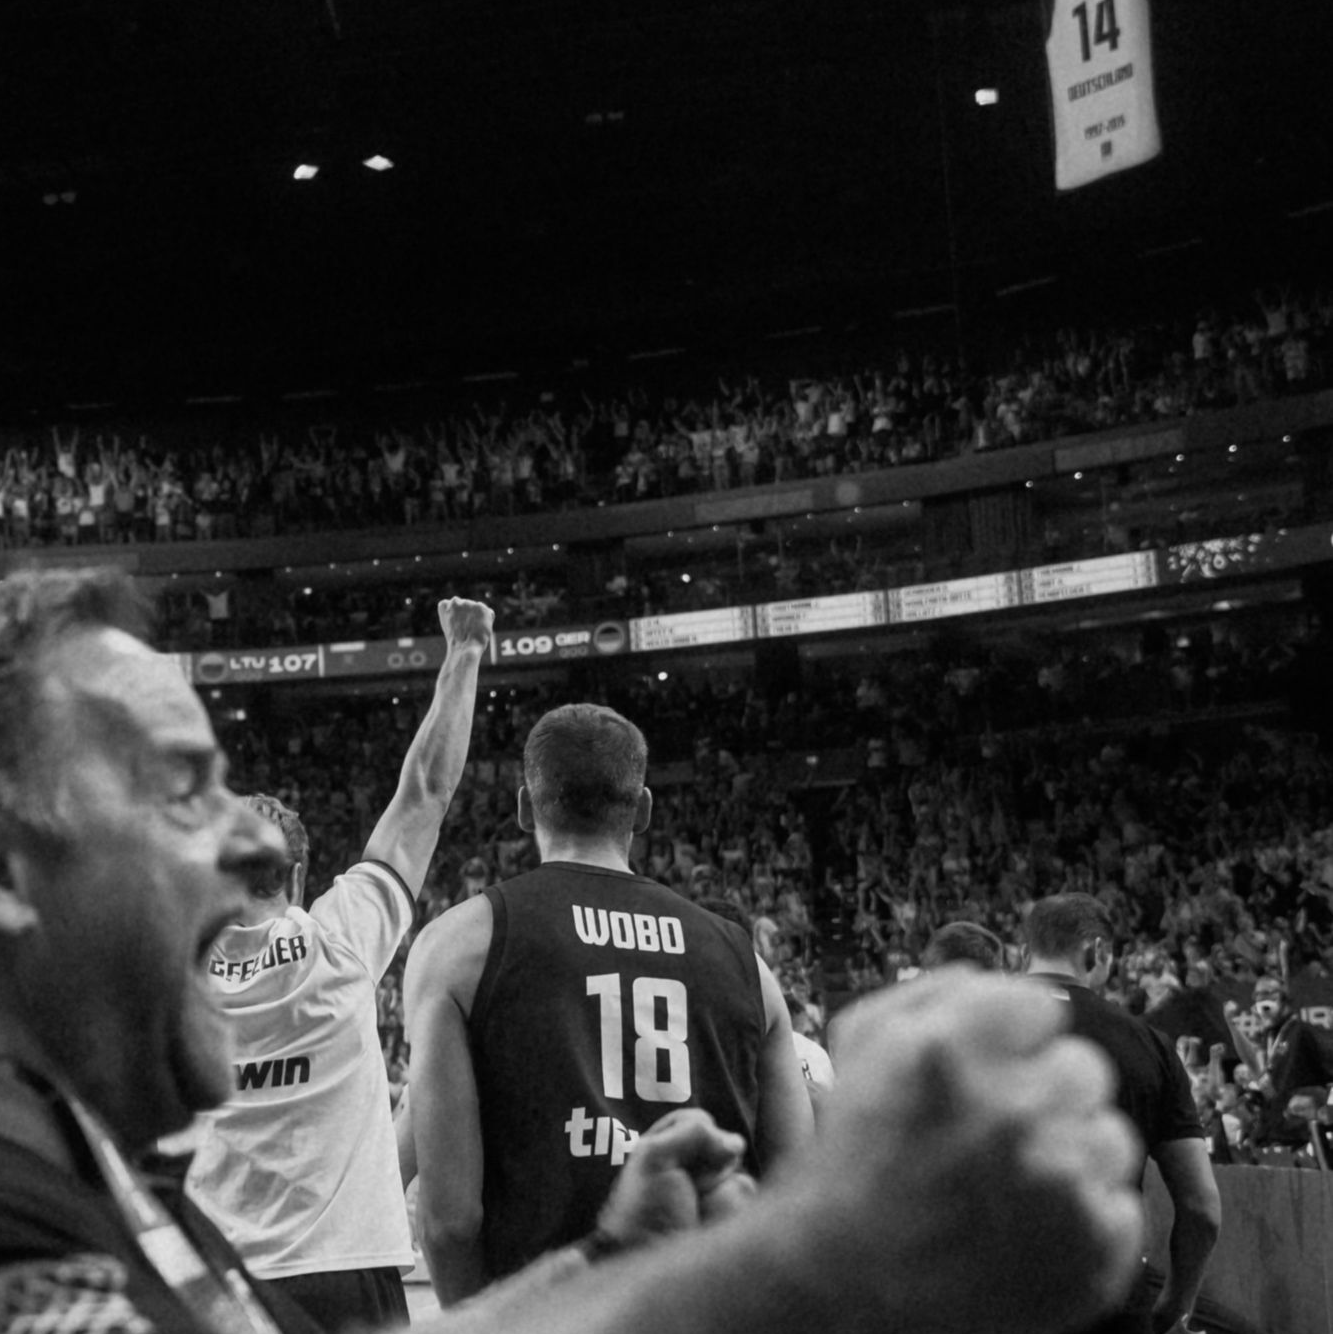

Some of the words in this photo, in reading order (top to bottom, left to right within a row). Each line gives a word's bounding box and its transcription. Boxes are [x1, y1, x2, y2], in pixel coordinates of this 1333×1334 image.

[1067, 62, 1134, 102] DEUTSCHLAND
[230, 656, 266, 670] LTU
[269, 653, 317, 673] 107
[501, 636, 554, 656] 109
[555, 631, 591, 647] GER
[572, 905, 685, 954] WOBO
[586, 973, 692, 1103] 18
